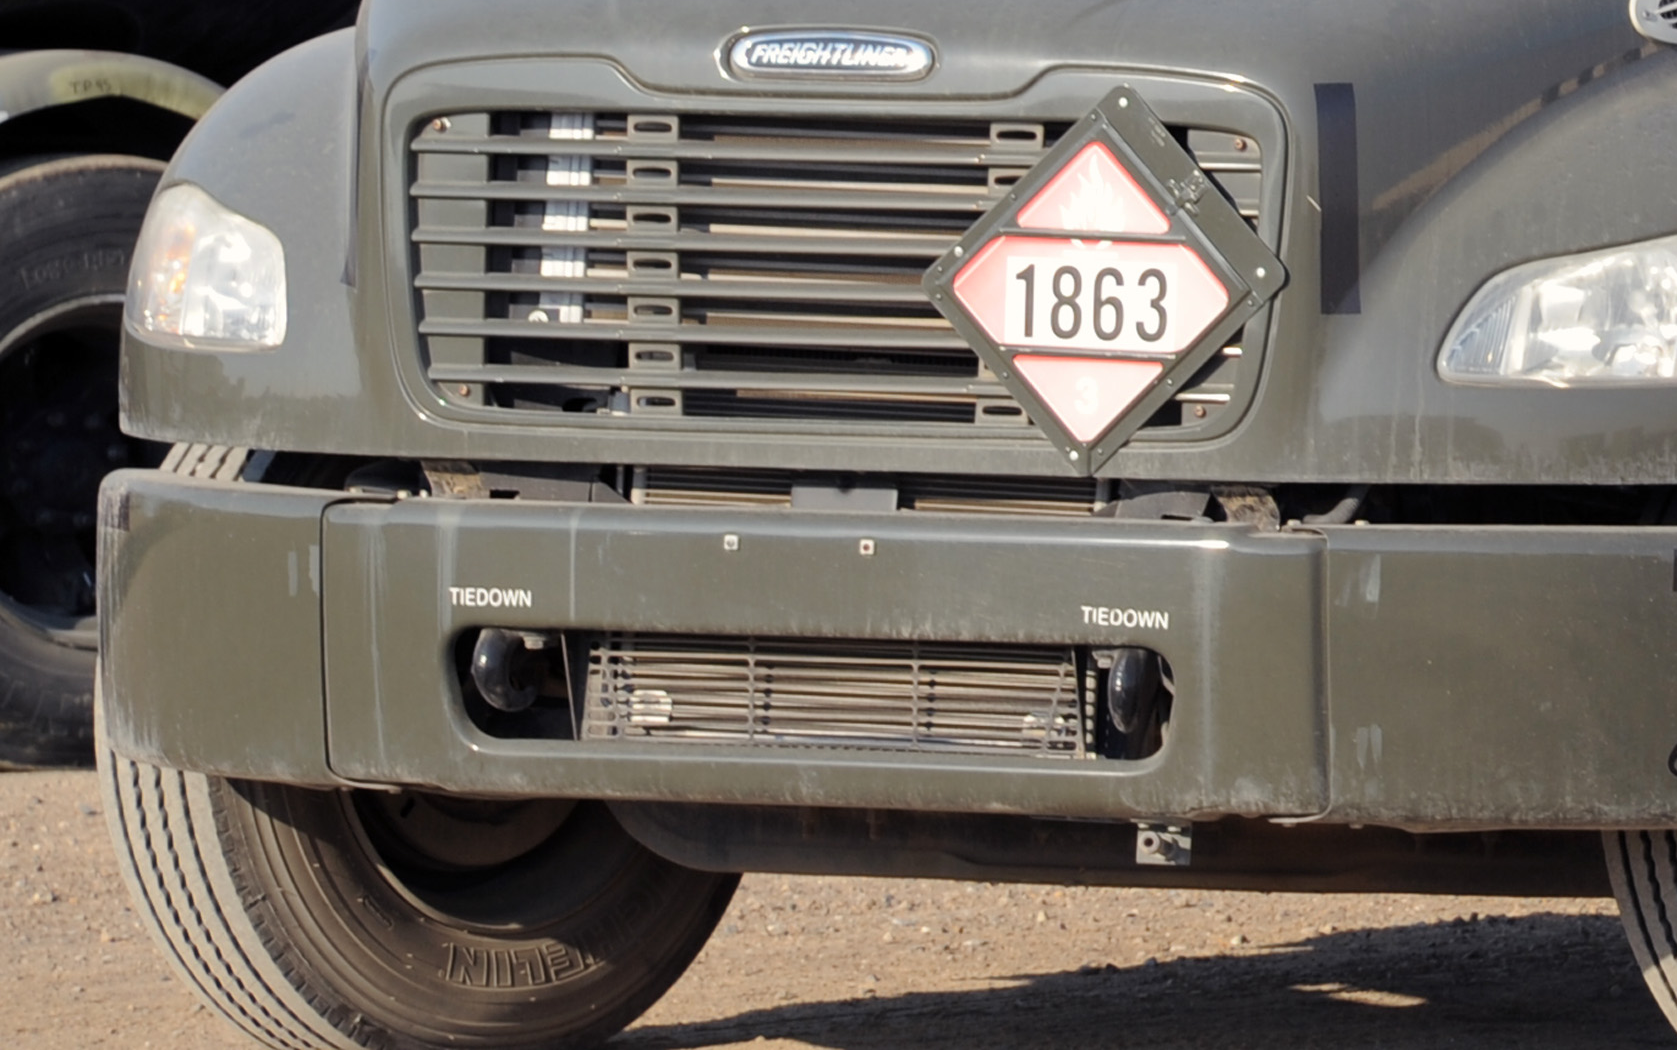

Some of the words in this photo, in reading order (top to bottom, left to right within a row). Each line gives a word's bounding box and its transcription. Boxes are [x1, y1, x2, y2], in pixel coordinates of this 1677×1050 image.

[751, 42, 908, 66] FREIGHTLINER
[1014, 262, 1169, 344] 1863
[1073, 376, 1100, 414] 3
[448, 586, 533, 608] TIEDOWN
[1081, 605, 1170, 631] TIEDOWN
